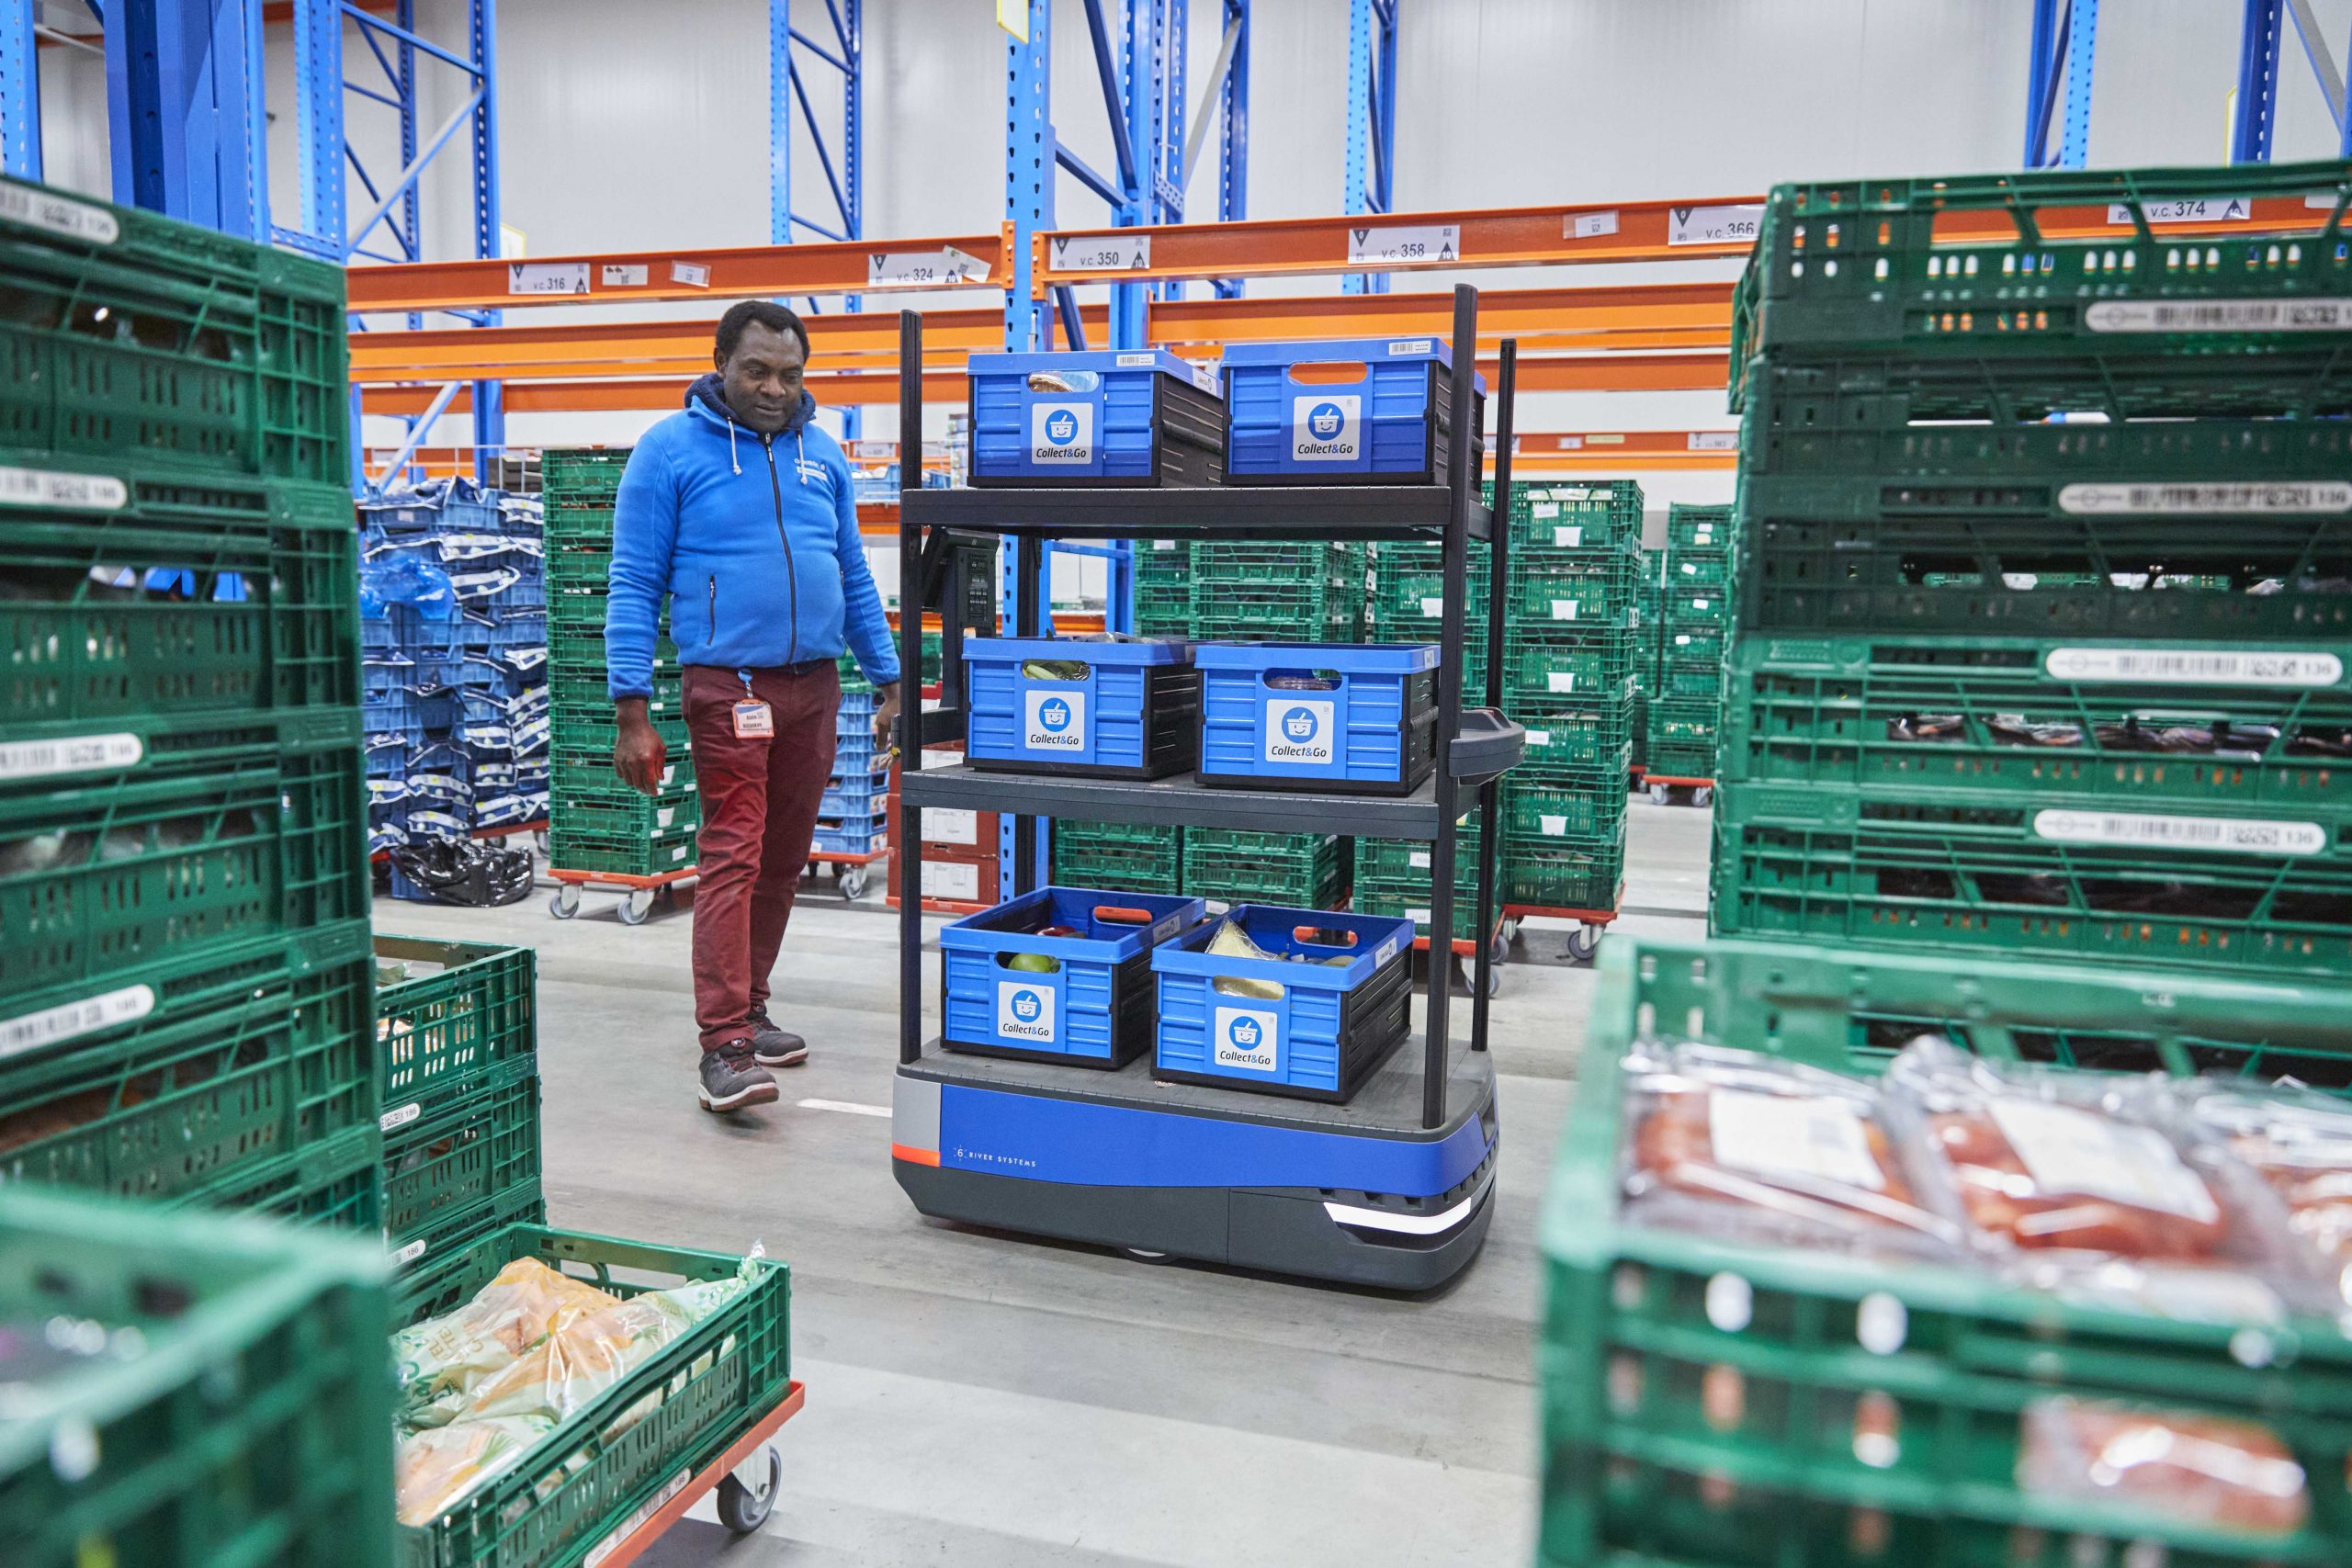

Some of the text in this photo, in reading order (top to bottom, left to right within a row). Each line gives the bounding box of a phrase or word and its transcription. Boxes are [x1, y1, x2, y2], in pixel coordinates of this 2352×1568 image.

[2175, 200, 2206, 217] 374
[1727, 221, 1755, 238] 366
[1400, 243, 1425, 258] 358
[1097, 251, 1119, 265] 350
[912, 267, 933, 281] 324
[547, 276, 565, 290] 316
[1035, 447, 1087, 458] Collect&Go
[1297, 443, 1353, 455] Collect&Go
[1030, 734, 1080, 746] Collect&Go
[1271, 745, 1327, 758] Collect&Go
[1002, 1022, 1049, 1037] Collect&Go
[1219, 1050, 1272, 1066] Collect&Go
[968, 1151, 993, 1161] RIVER
[997, 1156, 1036, 1168] SYSTEMS
